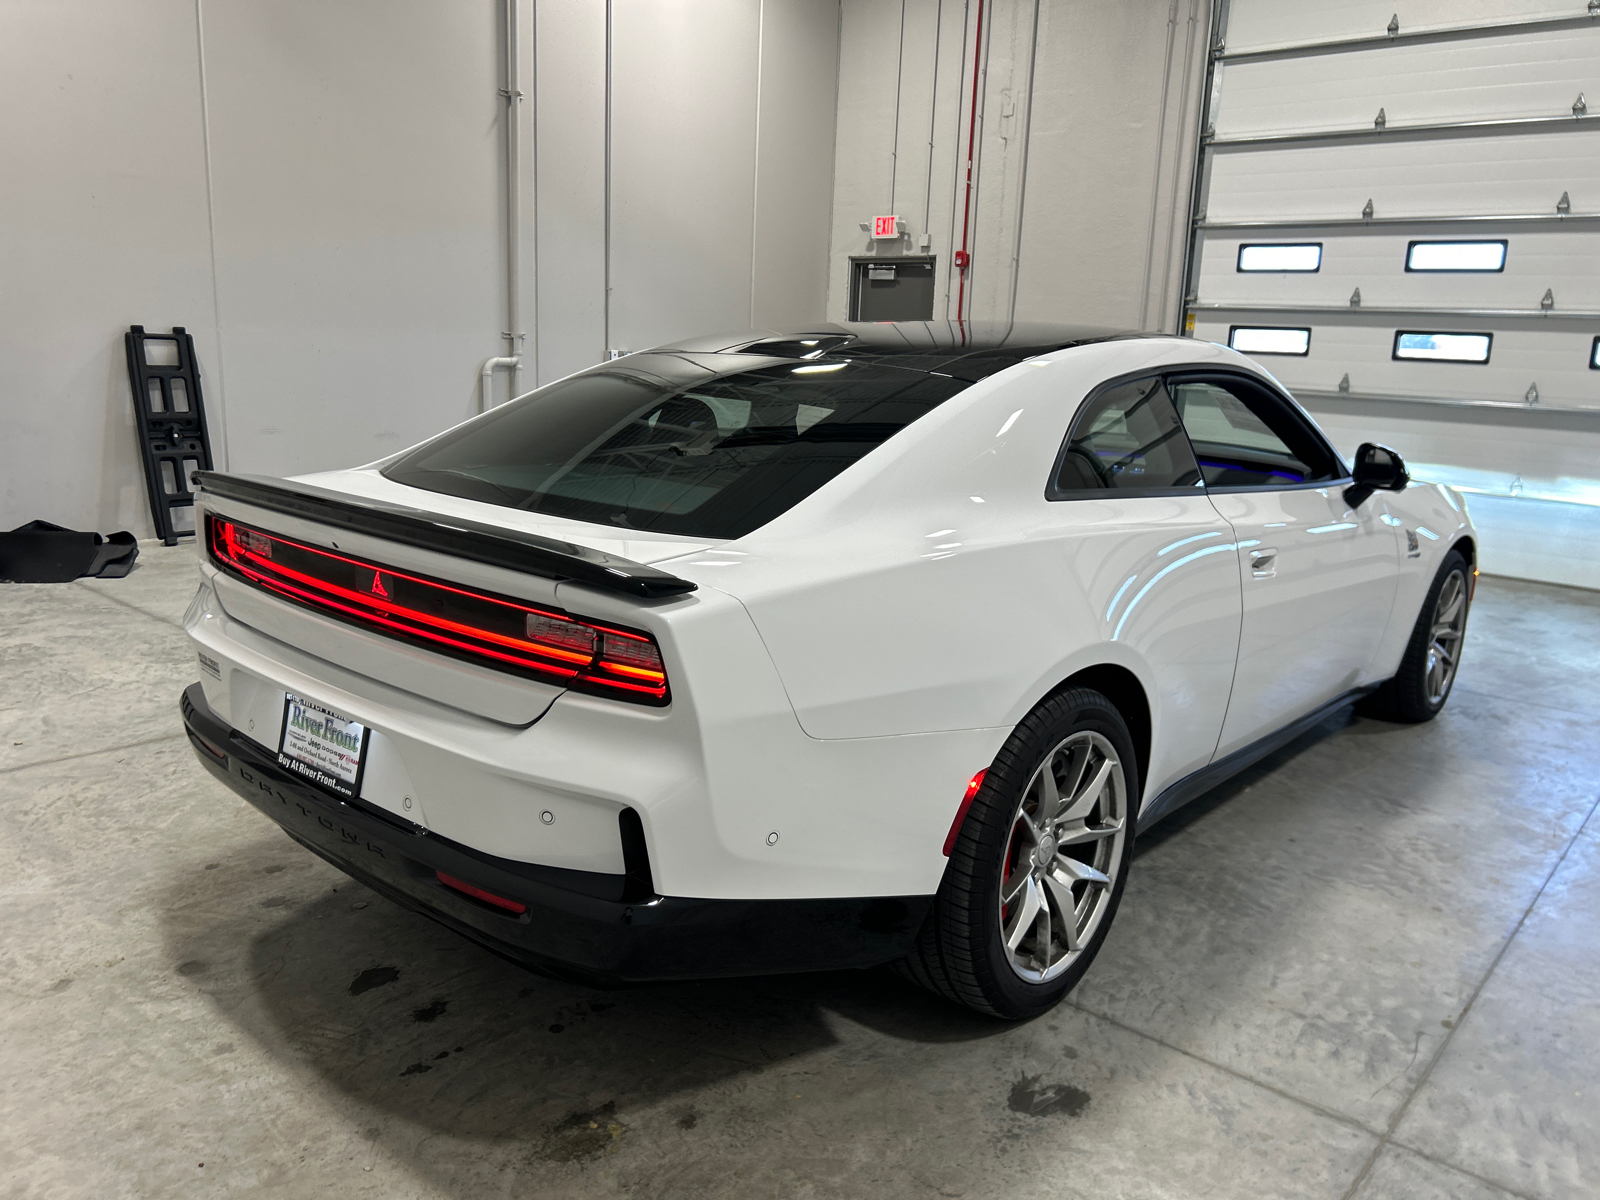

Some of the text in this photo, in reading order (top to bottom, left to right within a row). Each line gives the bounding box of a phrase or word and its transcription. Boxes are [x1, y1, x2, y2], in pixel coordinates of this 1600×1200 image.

[875, 216, 895, 236] EXIT
[307, 737, 321, 750] Jeep
[278, 753, 291, 768] Buy
[290, 760, 299, 771] At
[299, 763, 317, 779] River
[317, 771, 352, 796] Front.com
